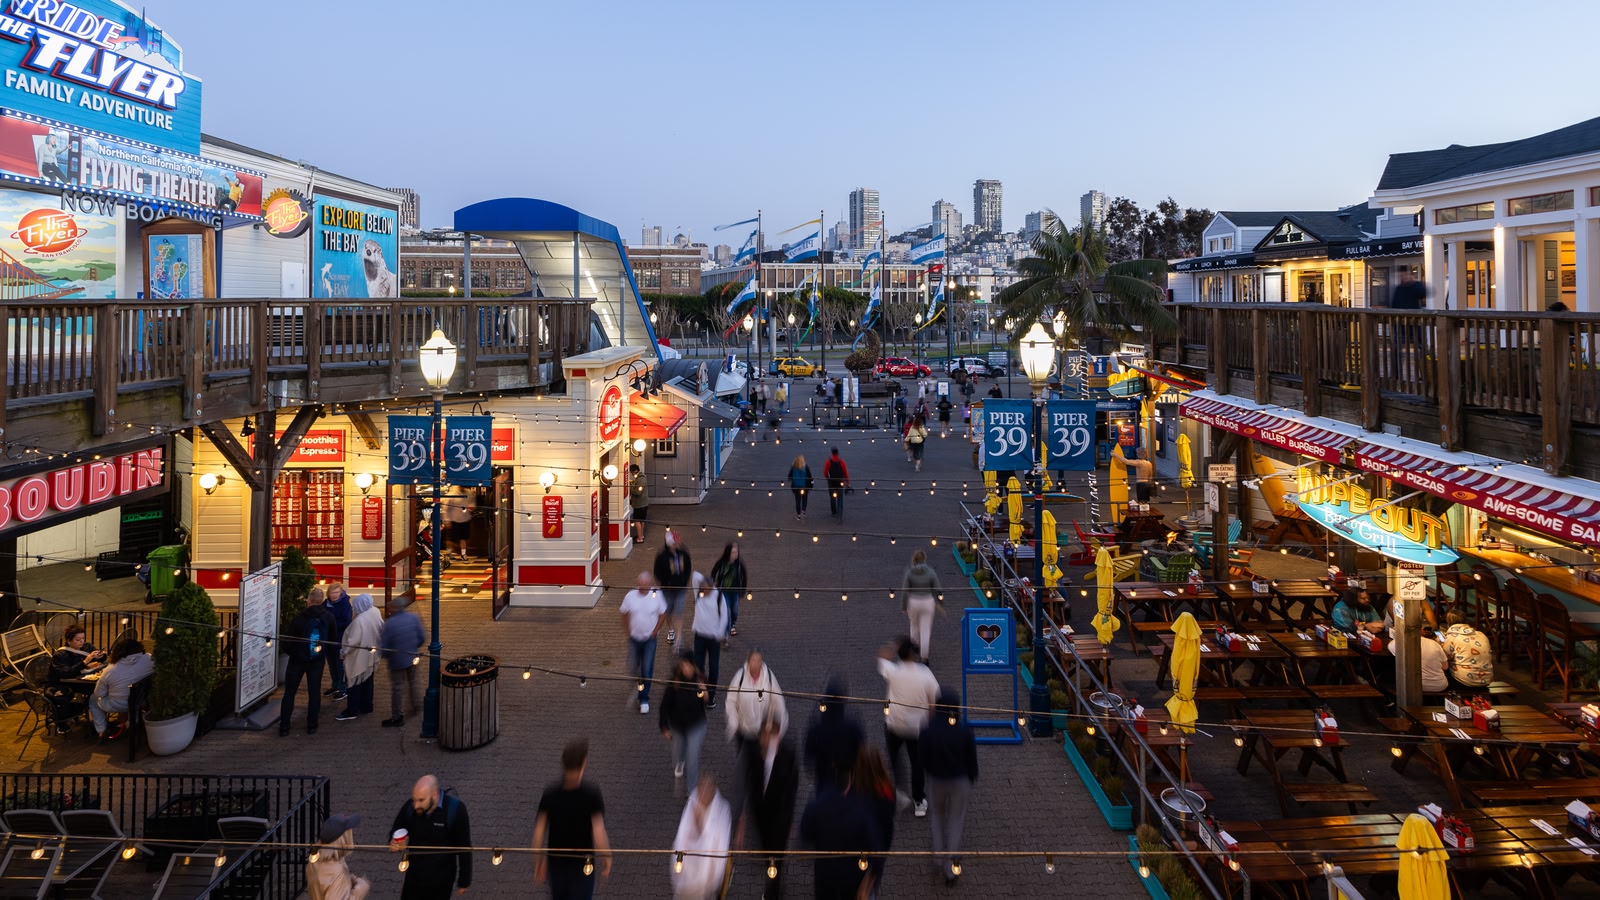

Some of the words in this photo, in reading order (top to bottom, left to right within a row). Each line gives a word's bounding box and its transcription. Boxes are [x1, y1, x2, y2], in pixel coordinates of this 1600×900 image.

[33, 28, 186, 108] FLYER
[5, 69, 74, 104] FAMILY
[79, 91, 173, 131] ADVENTURE
[99, 144, 140, 162] Northern
[141, 154, 186, 174] California's
[187, 165, 203, 179] Only
[81, 156, 144, 194] FLYING
[147, 170, 216, 207] THEATER
[61, 192, 117, 217] NOW
[275, 201, 297, 215] The
[40, 214, 70, 230] The
[271, 210, 299, 228] Flyer
[322, 205, 364, 231] EXPLORE
[366, 213, 394, 235] BELOW
[26, 224, 75, 246] Flyer
[323, 230, 342, 251] THE
[343, 234, 360, 253] BAY
[1402, 241, 1413, 249] BAY
[1415, 240, 1425, 248] VIE
[56, 239, 82, 257] FRANCISCO
[1346, 247, 1358, 255] FULL
[1157, 393, 1178, 403] ATM
[989, 412, 1026, 426] PIER
[1053, 412, 1089, 426] PIER
[1215, 416, 1239, 431] SALADS
[300, 435, 339, 444] moothies
[394, 427, 425, 441] PIER
[450, 428, 486, 442] PIER
[988, 426, 1028, 457] 39
[1051, 427, 1091, 458] 39
[1260, 429, 1287, 445] KILLER
[1288, 439, 1327, 457] BURGERS
[299, 447, 338, 456] Espresso
[392, 441, 427, 471] 39
[449, 442, 488, 472] 39
[1406, 472, 1446, 494] PIZZAS
[1297, 465, 1447, 552] WIPEOUT
[1483, 496, 1564, 532] AWESOME
[1358, 519, 1397, 554] Grill
